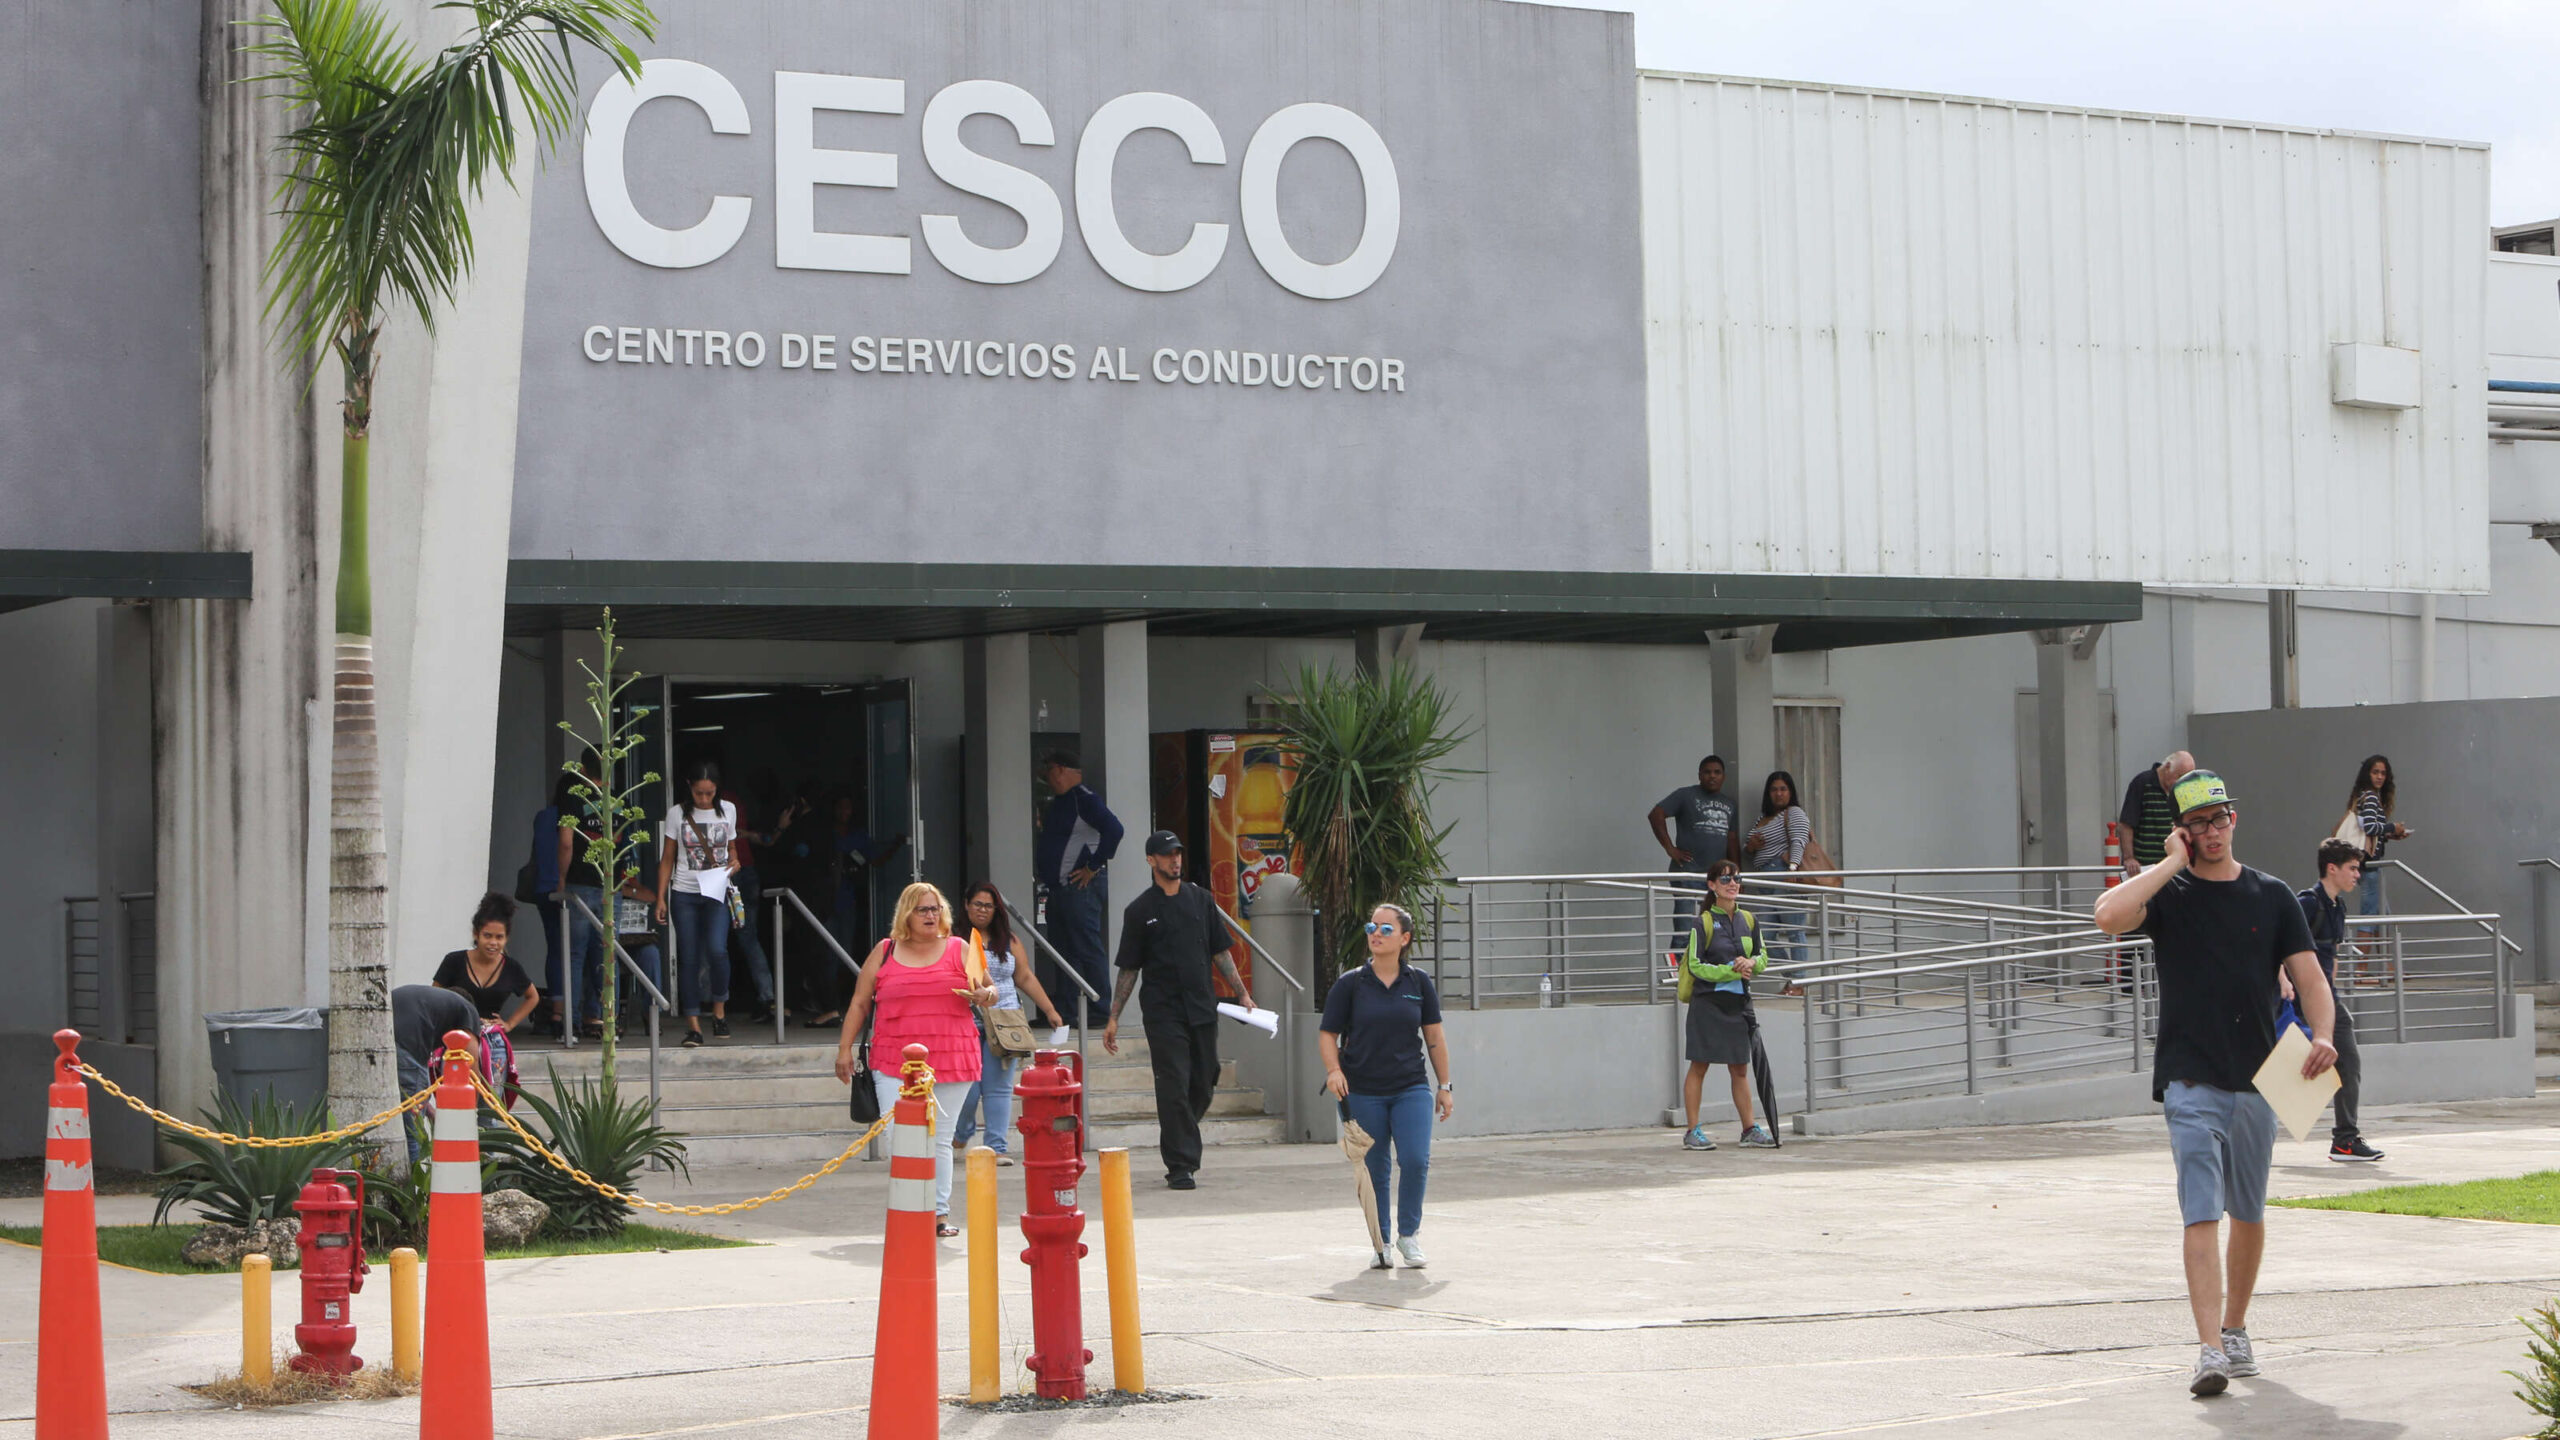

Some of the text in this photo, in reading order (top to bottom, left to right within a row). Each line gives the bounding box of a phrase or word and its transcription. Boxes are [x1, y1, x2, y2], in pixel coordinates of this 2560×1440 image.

[583, 57, 1402, 300] CESCO
[583, 324, 1406, 393] CENTRO DE SERVICIOS AL CONDUCTOR
